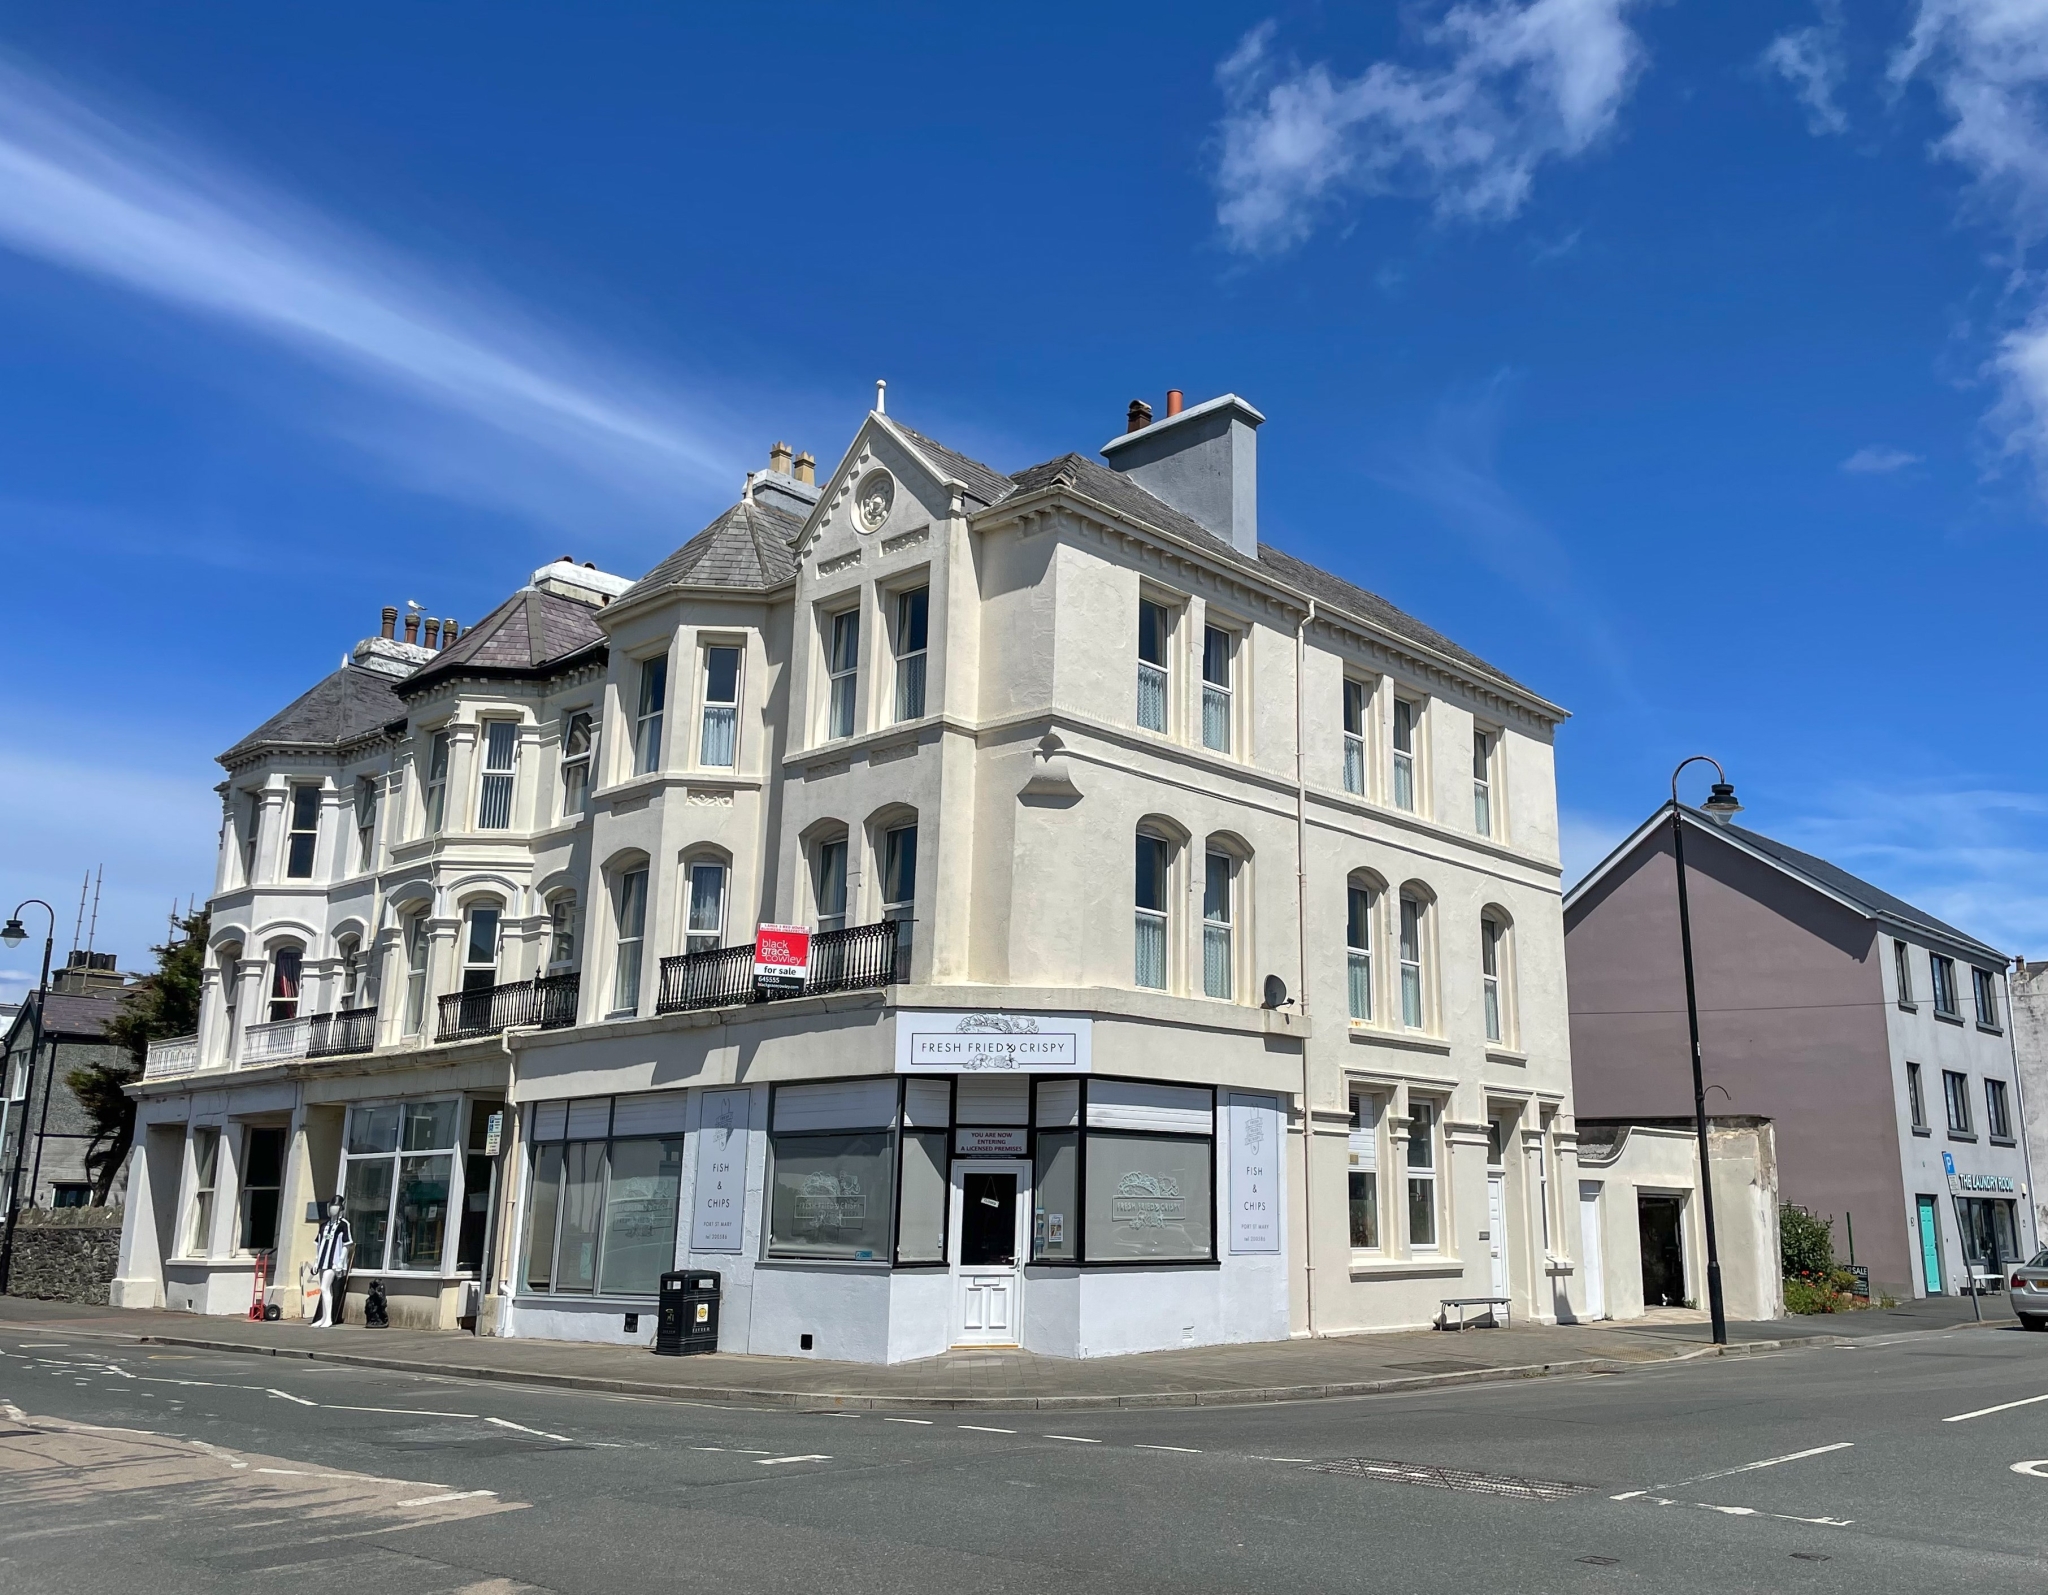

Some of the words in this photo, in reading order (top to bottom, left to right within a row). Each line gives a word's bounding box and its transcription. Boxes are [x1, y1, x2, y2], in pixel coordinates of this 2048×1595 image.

[762, 938, 788, 949] black
[761, 947, 790, 957] grace
[765, 954, 802, 966] cowley
[764, 966, 777, 974] for
[778, 967, 797, 976] sale
[758, 976, 780, 984] 645555
[921, 1042, 961, 1053] FRESH
[968, 1042, 1004, 1053] FRIED
[1019, 1042, 1065, 1053] CRISPY
[712, 1163, 730, 1173] FISH
[1945, 1156, 1952, 1171] P
[1246, 1166, 1263, 1176] FISH
[716, 1182, 722, 1190] &
[1959, 1173, 1971, 1190] THE
[1971, 1174, 1997, 1192] LAUNDRY
[1996, 1175, 2014, 1192] ROOM
[1252, 1184, 1257, 1193] &
[707, 1198, 730, 1209] CHIPS
[1117, 1202, 1136, 1212] FRESH
[1138, 1202, 1154, 1212] FRIED
[1160, 1202, 1181, 1212] CRISPY
[1244, 1201, 1266, 1211] CHIPS
[1851, 1266, 1868, 1275] SALE
[692, 1326, 711, 1334] LITTER
